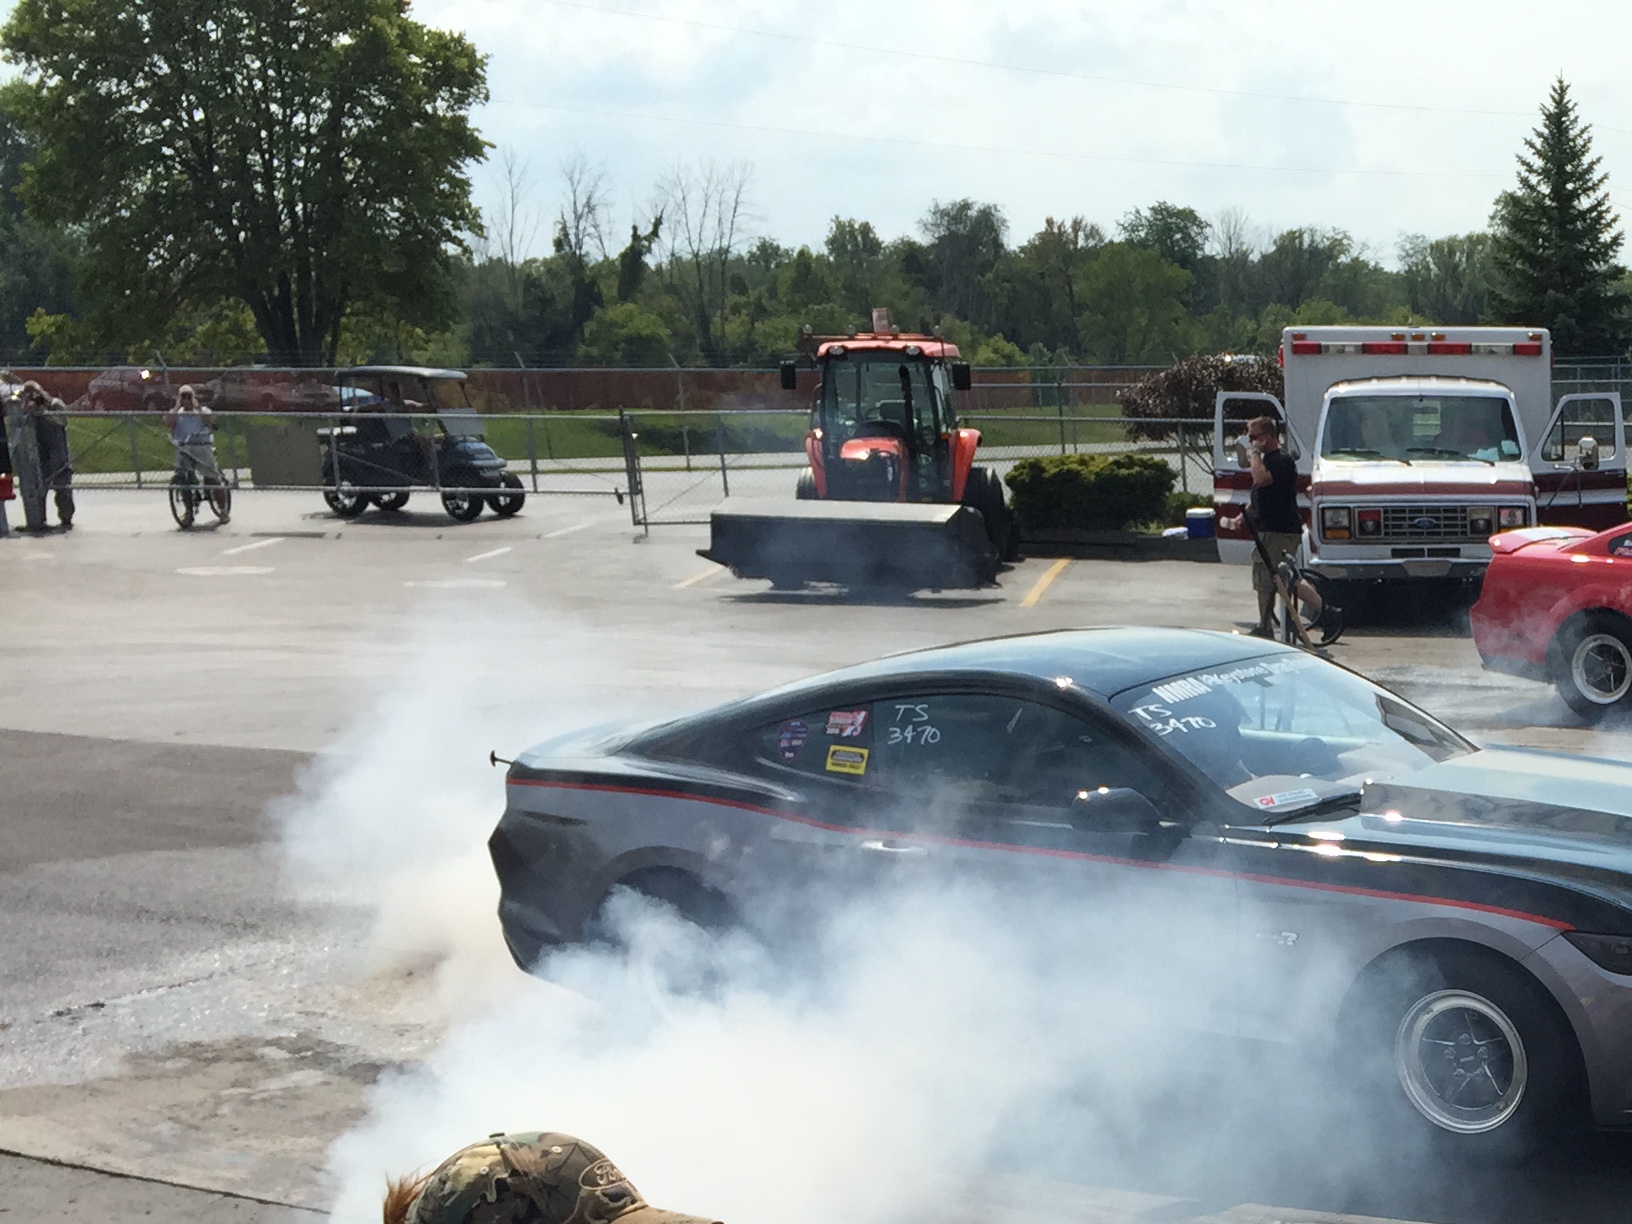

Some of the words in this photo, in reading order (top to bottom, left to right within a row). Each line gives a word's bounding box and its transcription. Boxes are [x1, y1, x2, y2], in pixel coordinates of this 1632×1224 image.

[894, 704, 929, 722] TS
[887, 725, 941, 745] 3470
[1150, 716, 1217, 736] 3470
